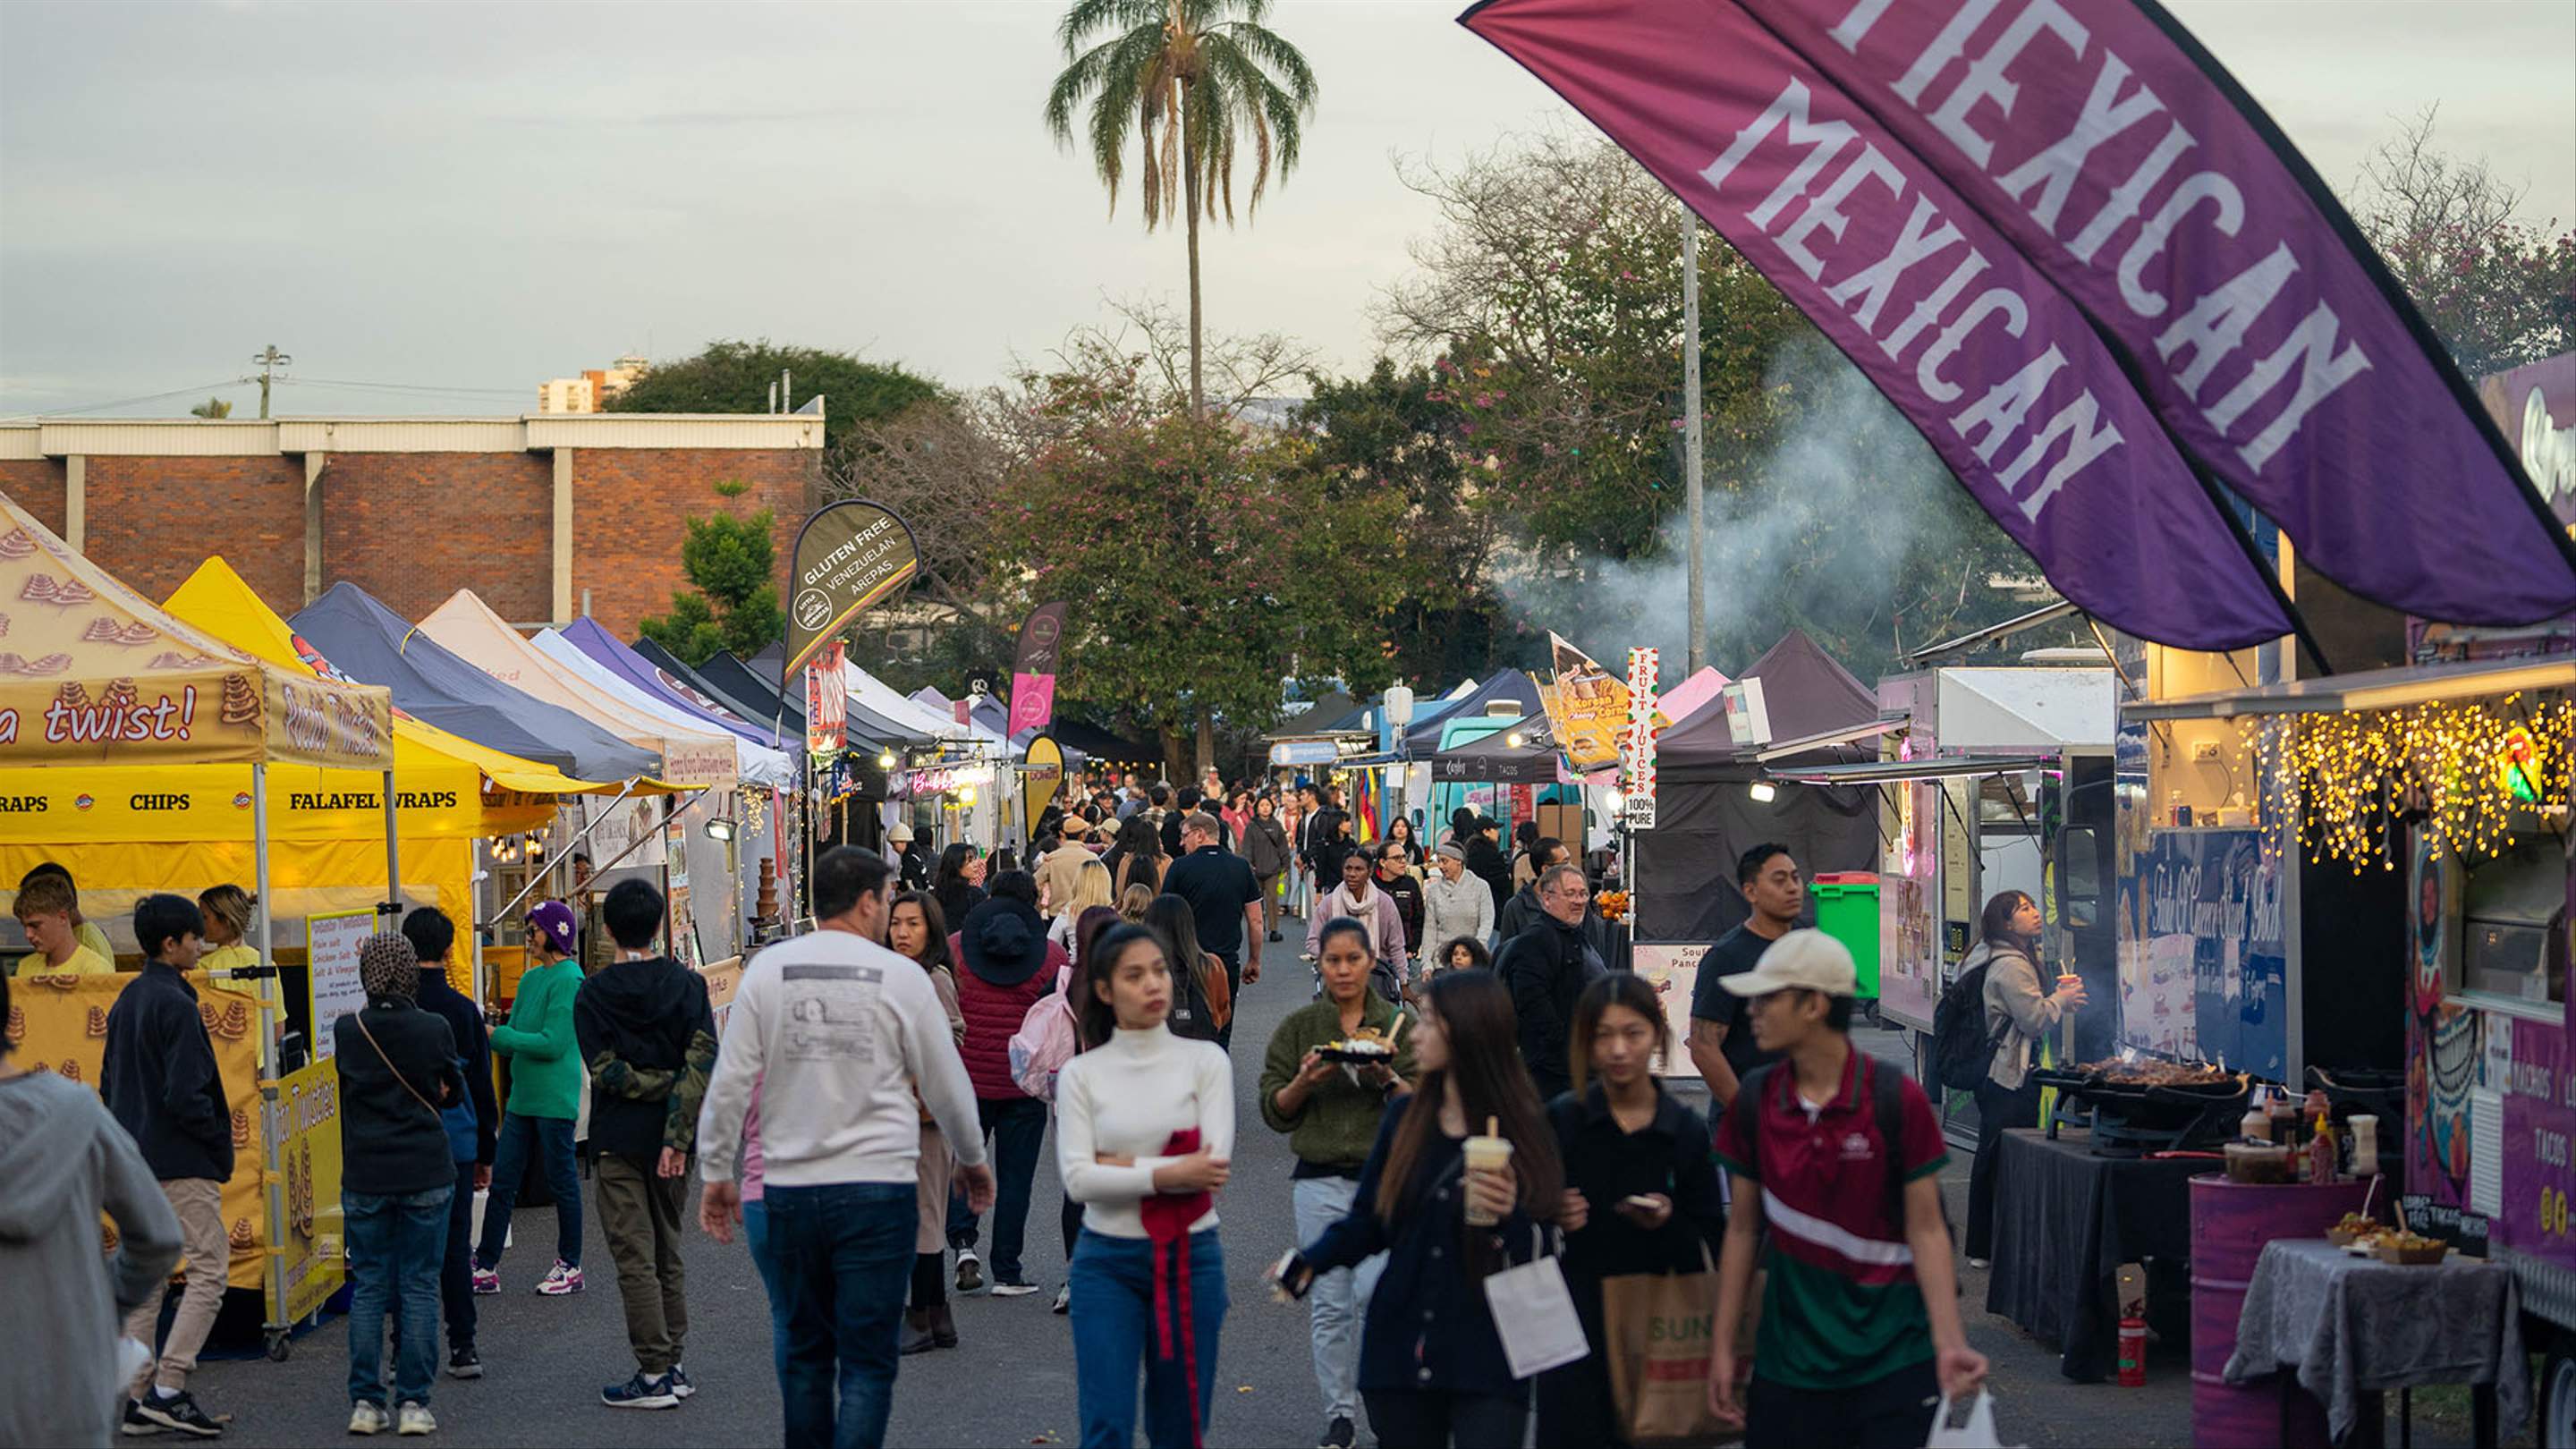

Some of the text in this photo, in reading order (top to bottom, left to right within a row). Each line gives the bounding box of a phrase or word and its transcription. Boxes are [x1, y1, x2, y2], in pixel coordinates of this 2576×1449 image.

[1697, 75, 2125, 524] MEXICAN
[804, 516, 892, 585] GLUTEN FREE
[826, 537, 896, 590] VENEZUELAN
[851, 560, 894, 596] AREPAS
[0, 685, 196, 744] a twist!
[1574, 696, 1613, 708] Korean
[1637, 653, 1648, 793] FRUIT JUICES
[0, 795, 47, 812] RAPS
[130, 793, 190, 810] CHIPS
[290, 792, 380, 810] FALAFEL
[1629, 798, 1654, 811] 100%
[1628, 812, 1653, 825] PURE
[1672, 959, 1697, 968] Panc
[1682, 947, 1709, 957] Souf
